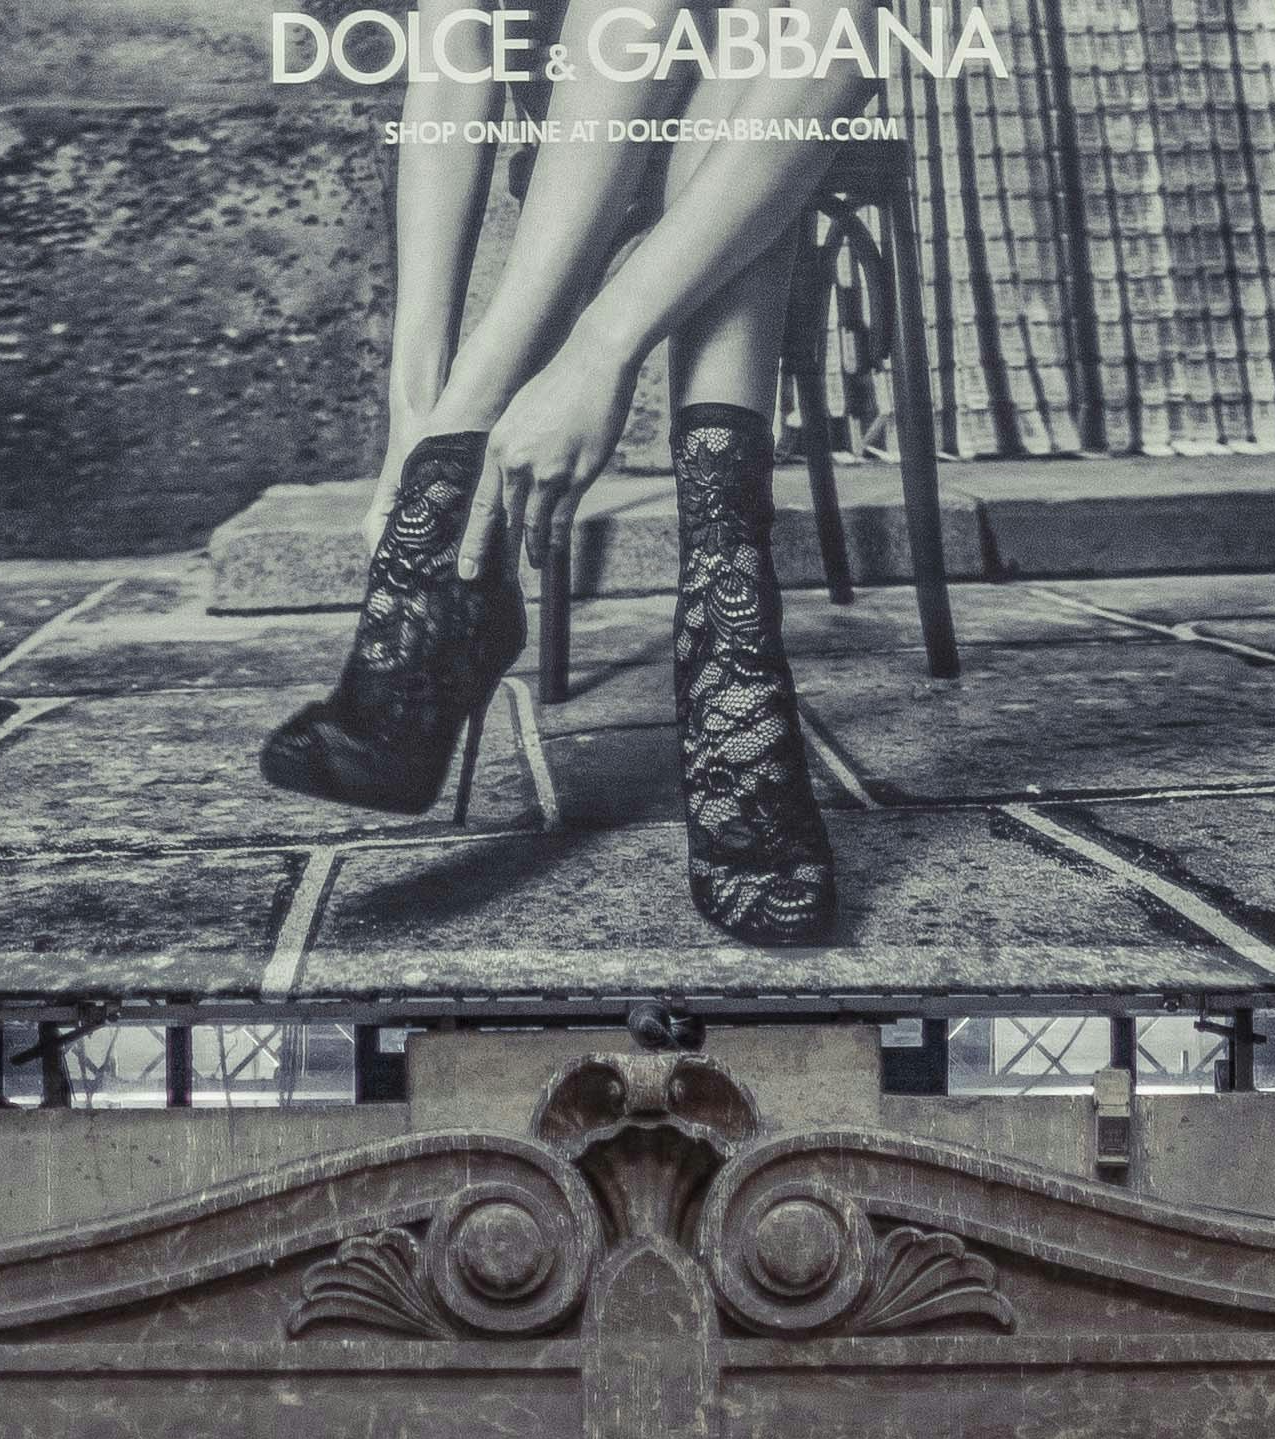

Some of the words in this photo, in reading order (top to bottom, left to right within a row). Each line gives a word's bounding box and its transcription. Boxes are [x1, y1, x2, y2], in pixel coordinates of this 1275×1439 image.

[272, 9, 530, 85] DOLCE
[544, 43, 577, 83] &
[586, 7, 1010, 83] GABBANA
[384, 120, 457, 145] SHOP
[463, 119, 562, 144] ONLINE
[569, 118, 602, 143] AT
[607, 116, 900, 143] DOLCEGABBANA.COM
